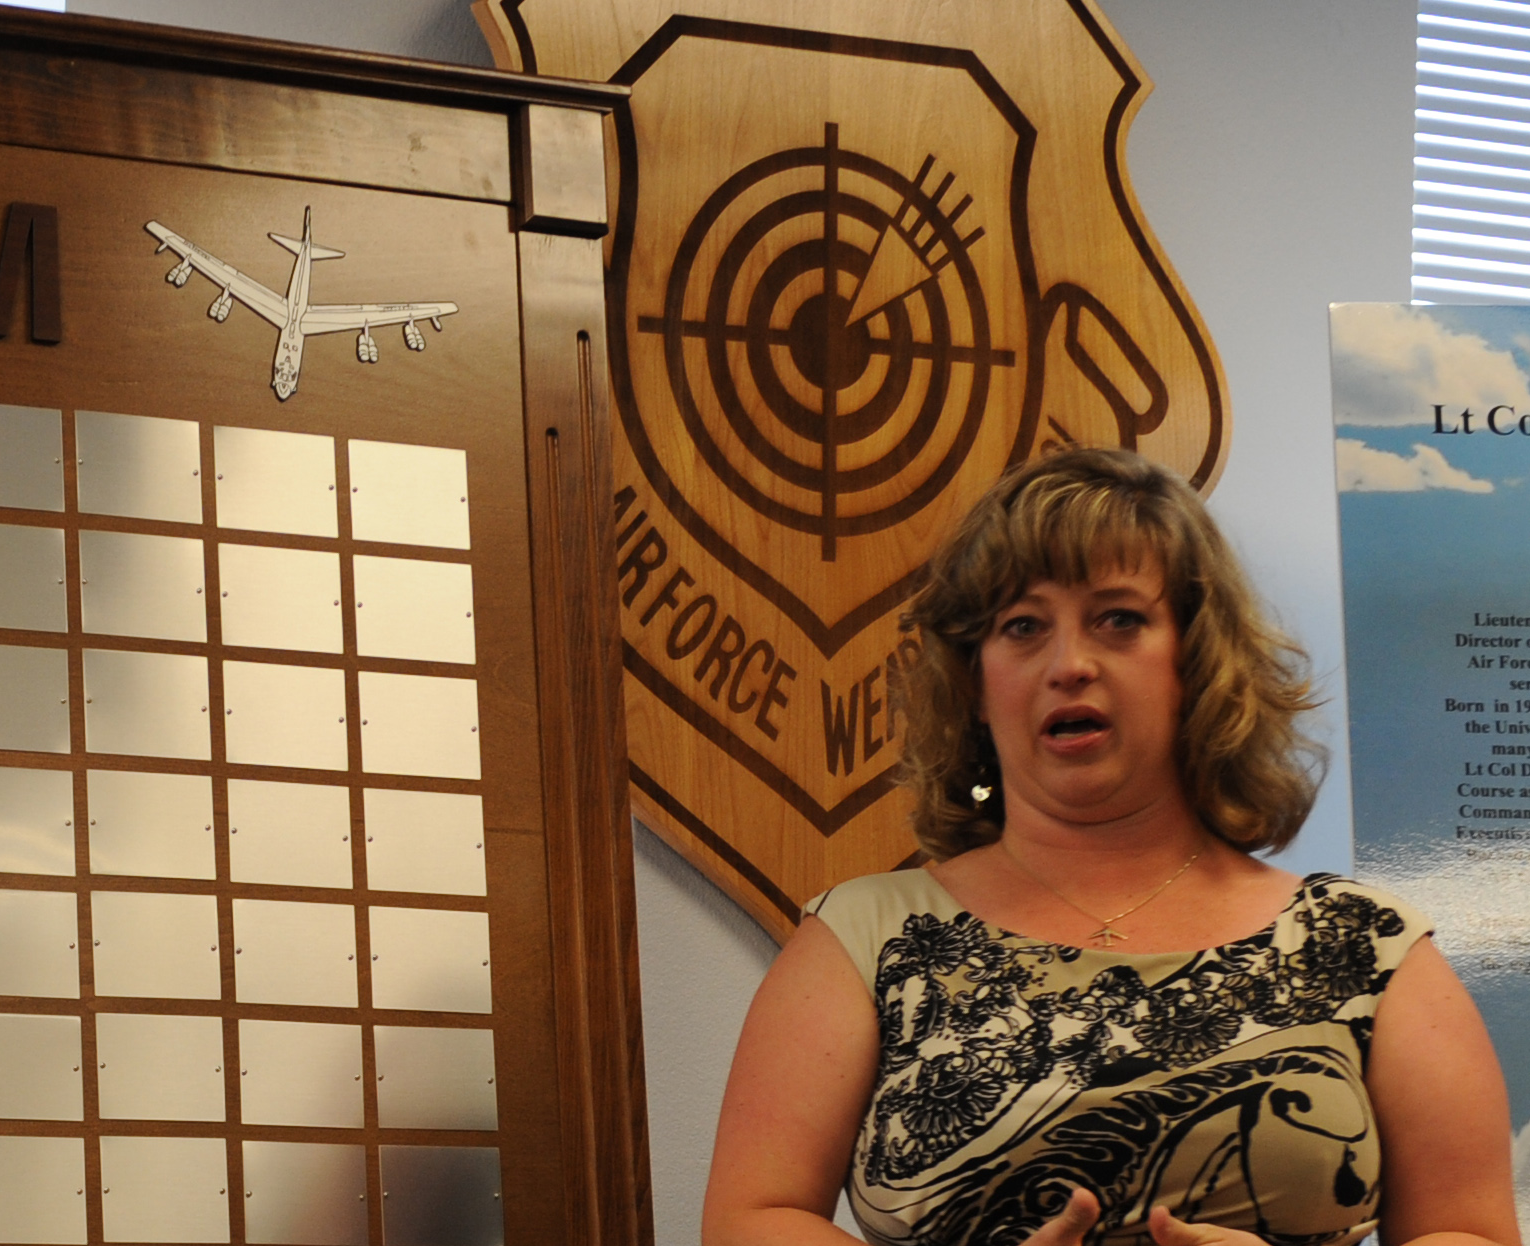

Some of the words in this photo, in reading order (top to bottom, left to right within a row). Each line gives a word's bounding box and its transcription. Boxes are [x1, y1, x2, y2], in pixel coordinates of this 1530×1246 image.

[1430, 404, 1475, 435] Lt
[1455, 633, 1522, 648] Director
[638, 566, 797, 742] FORCE
[1467, 655, 1494, 669] Air
[1445, 698, 1485, 712] Born
[1494, 699, 1510, 713] in
[1465, 720, 1490, 734] the
[1465, 762, 1483, 776] Lt
[1488, 762, 1516, 777] Col
[1457, 783, 1515, 798] Course
